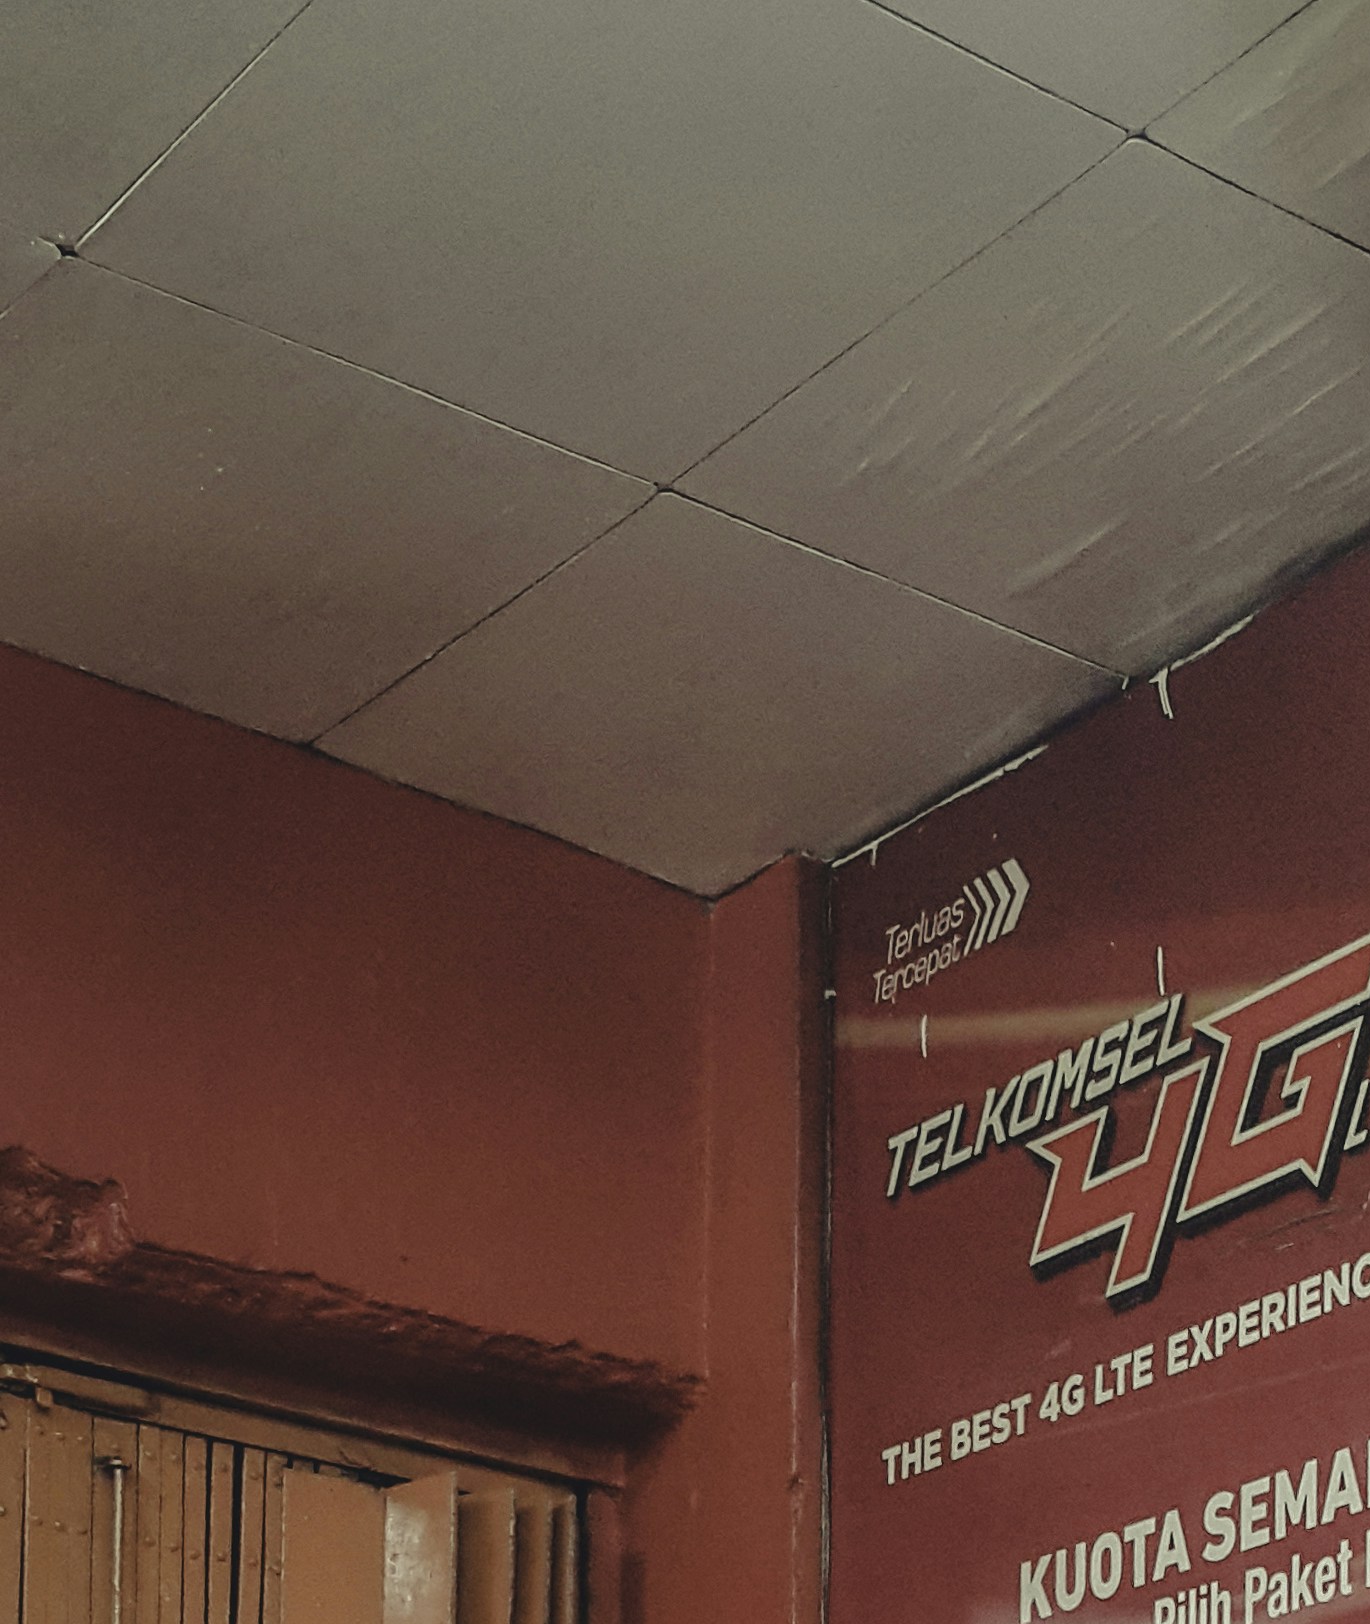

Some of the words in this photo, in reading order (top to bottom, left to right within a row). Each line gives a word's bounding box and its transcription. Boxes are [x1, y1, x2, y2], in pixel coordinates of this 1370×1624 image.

[873, 933, 962, 1005] Tercepat
[885, 897, 965, 965] Terluas
[885, 992, 1196, 1199] TELKOMSEL
[881, 1428, 942, 1486] THE
[949, 1393, 1033, 1461] BEST
[1038, 1373, 1086, 1423] 4G
[1093, 1343, 1154, 1405] LTE
